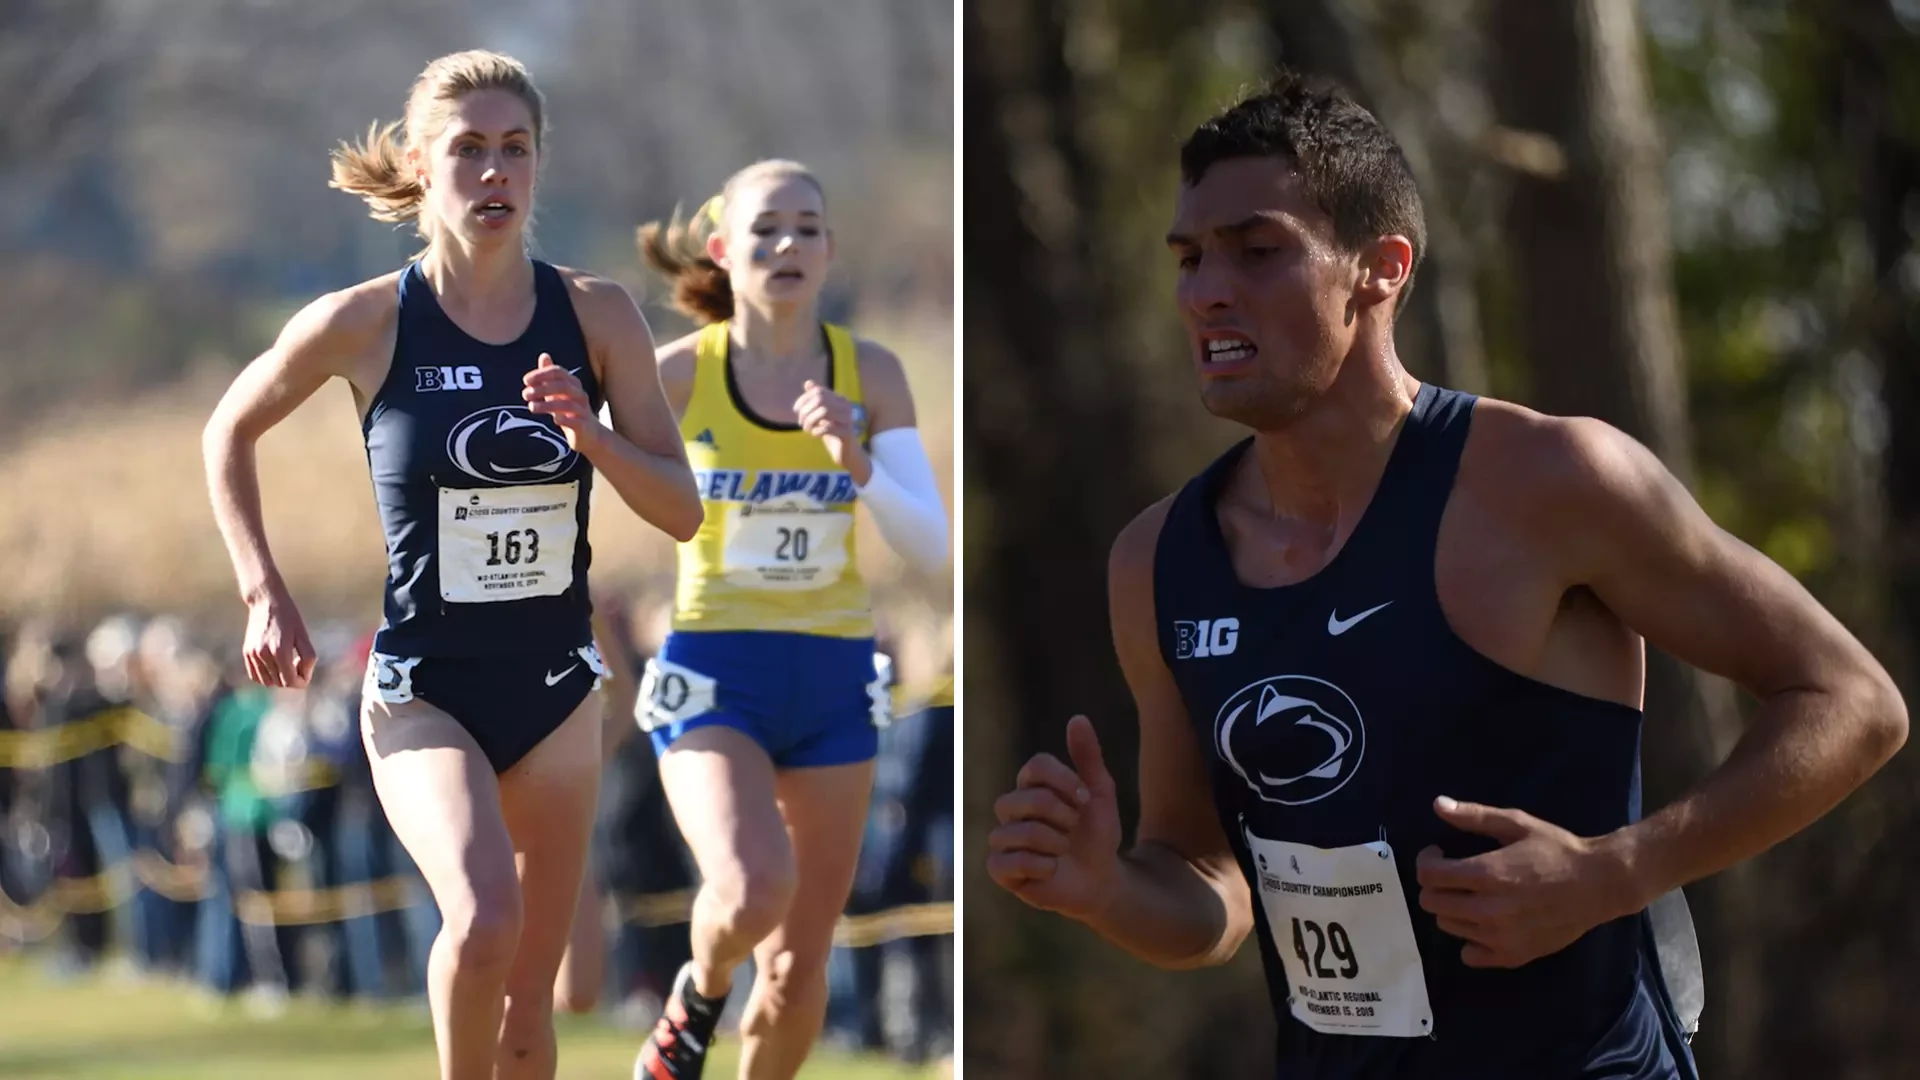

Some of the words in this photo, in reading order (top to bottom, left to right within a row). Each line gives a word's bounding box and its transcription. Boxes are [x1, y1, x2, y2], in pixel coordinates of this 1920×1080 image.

[695, 472, 859, 501] DELAWAR
[486, 528, 540, 566] 163
[775, 527, 809, 561] 20
[1281, 881, 1311, 895] COUNTRY
[1313, 882, 1383, 898] CHAMPIONSHIPS
[1291, 917, 1359, 980] 429
[1307, 1001, 1341, 1016] NOVEMBER
[1355, 1006, 1375, 1017] 2019
[1342, 992, 1382, 1003] REGIONAL
